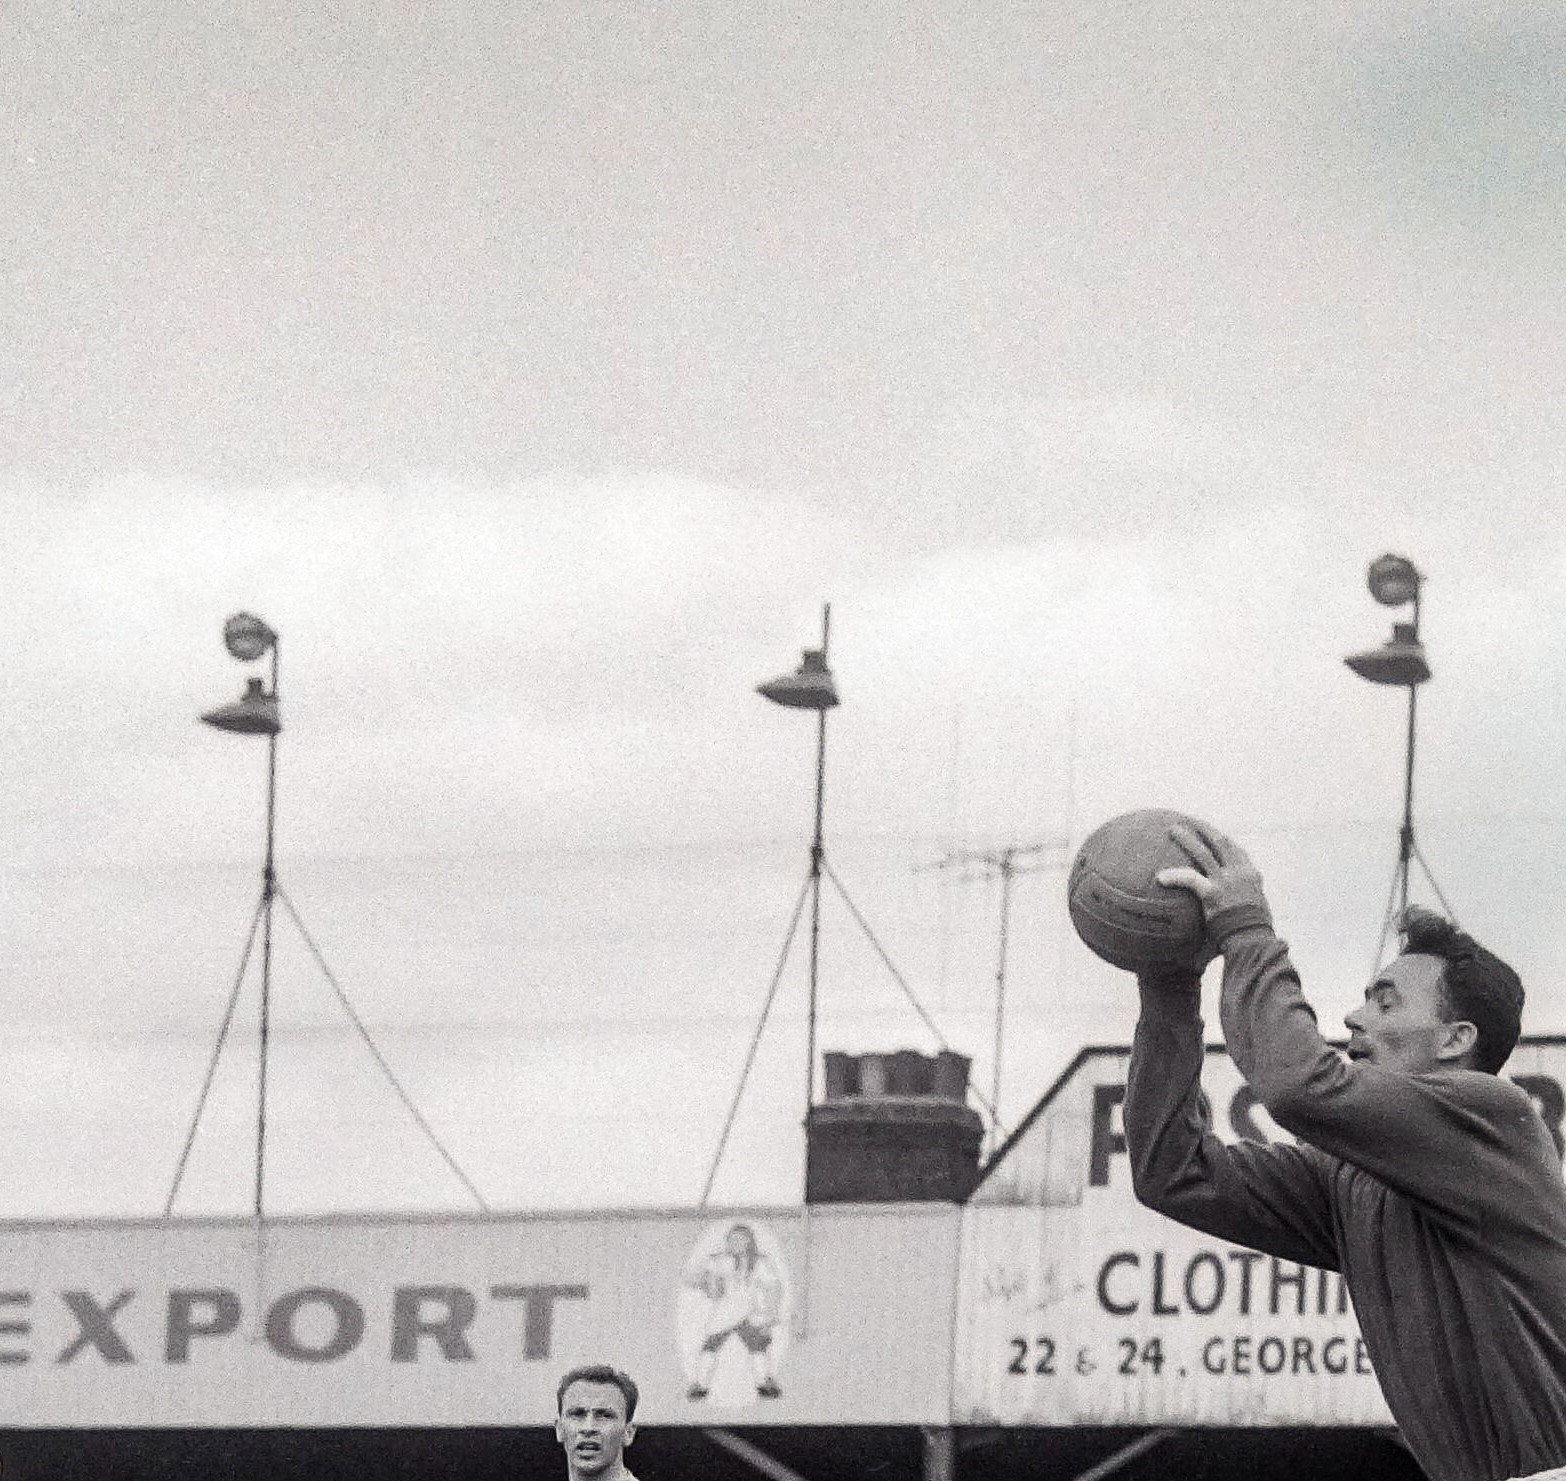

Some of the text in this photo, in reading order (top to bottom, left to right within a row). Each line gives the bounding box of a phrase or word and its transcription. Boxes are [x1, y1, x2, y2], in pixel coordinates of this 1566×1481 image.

[1097, 1250, 1347, 1316] CLOTHI
[1008, 1337, 1056, 1377] 22
[1202, 1335, 1373, 1376] GEORGE
